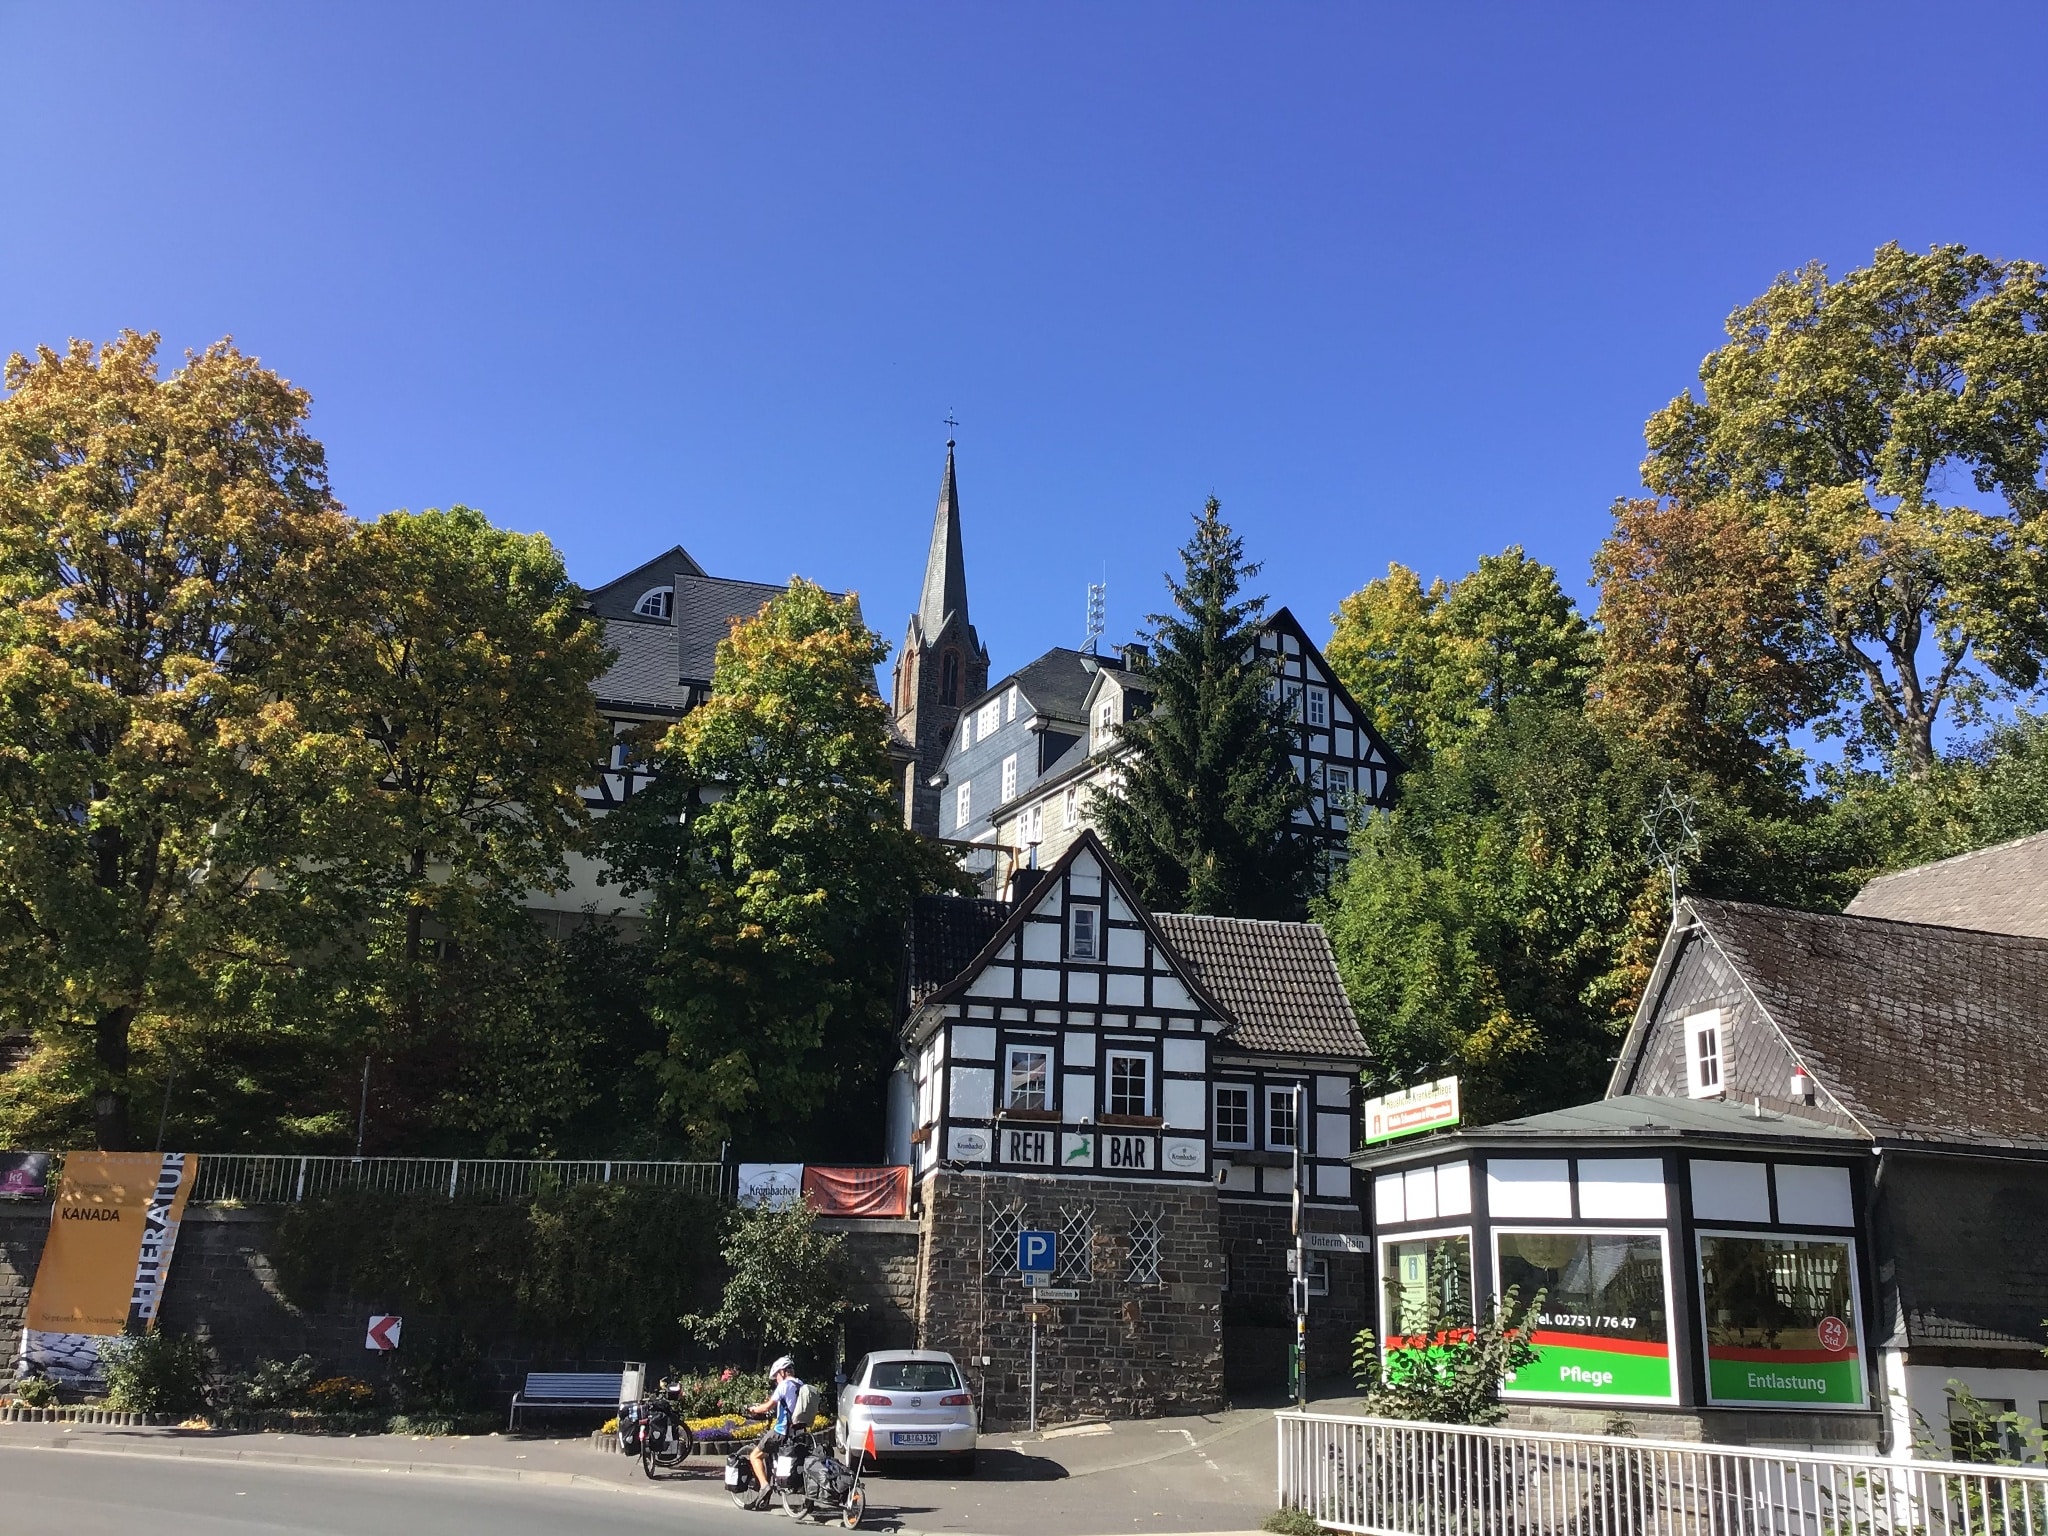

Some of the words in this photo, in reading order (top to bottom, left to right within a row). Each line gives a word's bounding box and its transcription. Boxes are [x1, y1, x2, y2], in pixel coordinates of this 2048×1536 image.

[957, 1142, 983, 1150] Krombacher
[1010, 1131, 1045, 1162] REH
[1110, 1136, 1146, 1168] BAR
[750, 1184, 796, 1196] Krombacher
[61, 1207, 121, 1222] KANADA
[1311, 1235, 1342, 1248] Unterm
[1027, 1236, 1047, 1266] P
[1555, 1314, 1592, 1327] 02751
[1595, 1316, 1601, 1328] /
[1603, 1316, 1619, 1328] 76
[1621, 1317, 1637, 1329] 47
[1825, 1321, 1842, 1336] 24
[1824, 1335, 1841, 1347] Std.
[1560, 1366, 1613, 1387] Pflege
[1747, 1372, 1827, 1394] Entlastung
